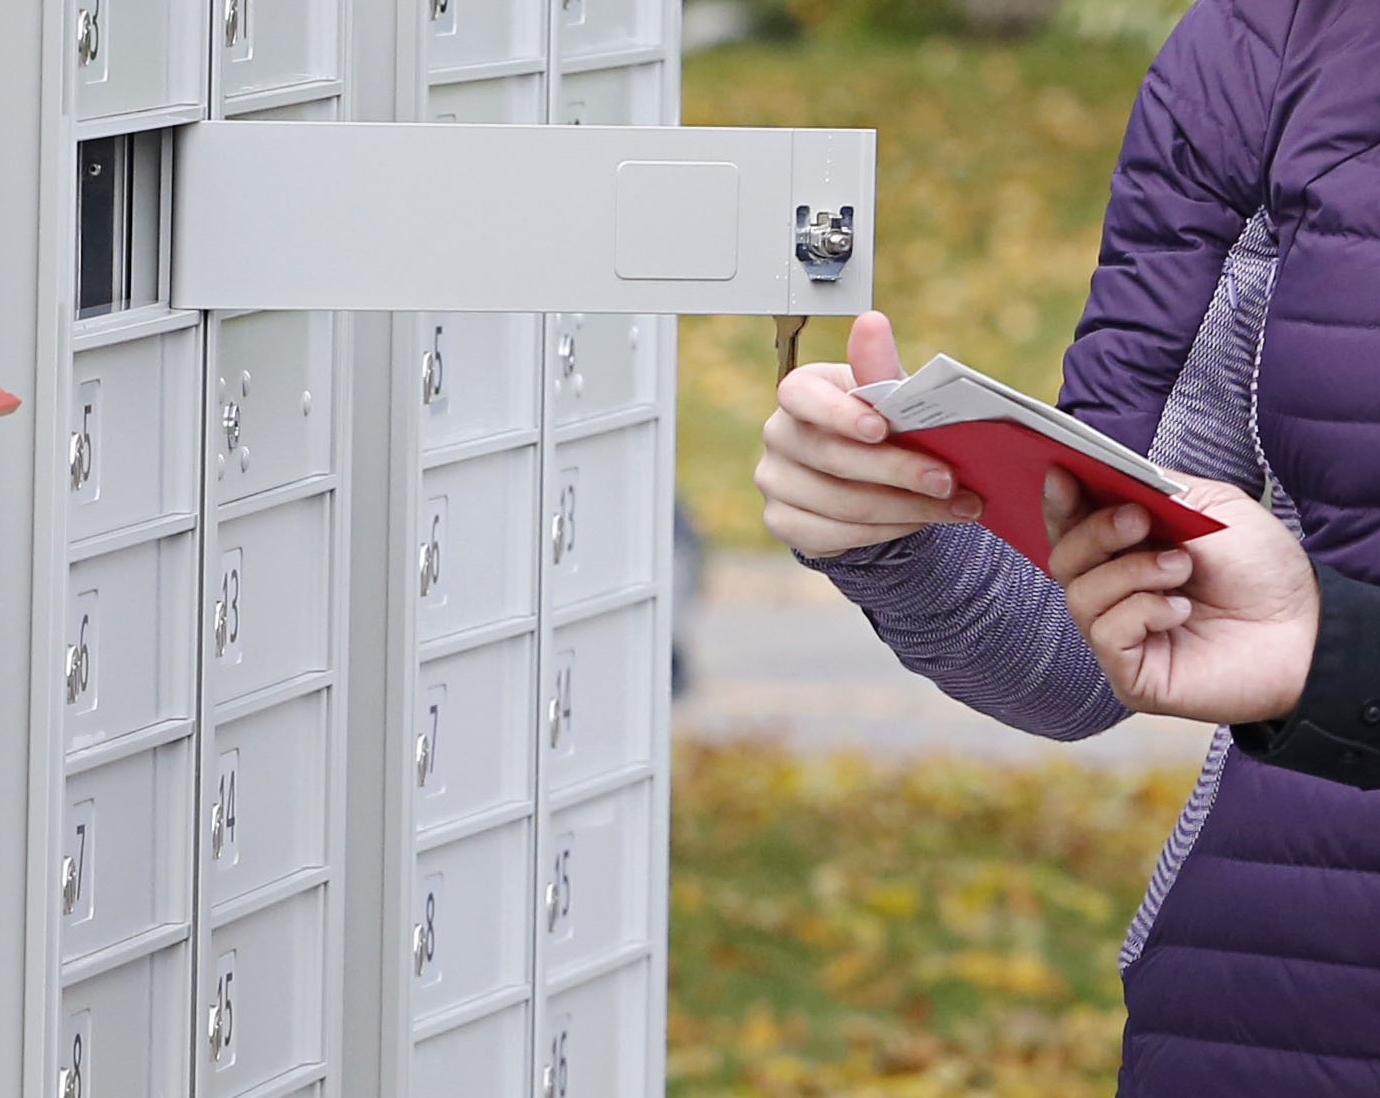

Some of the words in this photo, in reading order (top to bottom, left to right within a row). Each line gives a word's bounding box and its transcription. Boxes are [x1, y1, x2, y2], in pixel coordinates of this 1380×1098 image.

[434, 325, 443, 395] 5
[84, 405, 92, 482] 5
[432, 514, 440, 584] 6
[561, 485, 575, 552] 13
[223, 569, 239, 643] 13
[79, 614, 89, 692] 6
[430, 705, 439, 774] 7
[219, 770, 235, 848] 14
[77, 824, 86, 901] 7
[555, 850, 570, 917] 15
[426, 892, 435, 962] 8
[219, 972, 233, 1048] 15
[553, 1030, 568, 1098] 16
